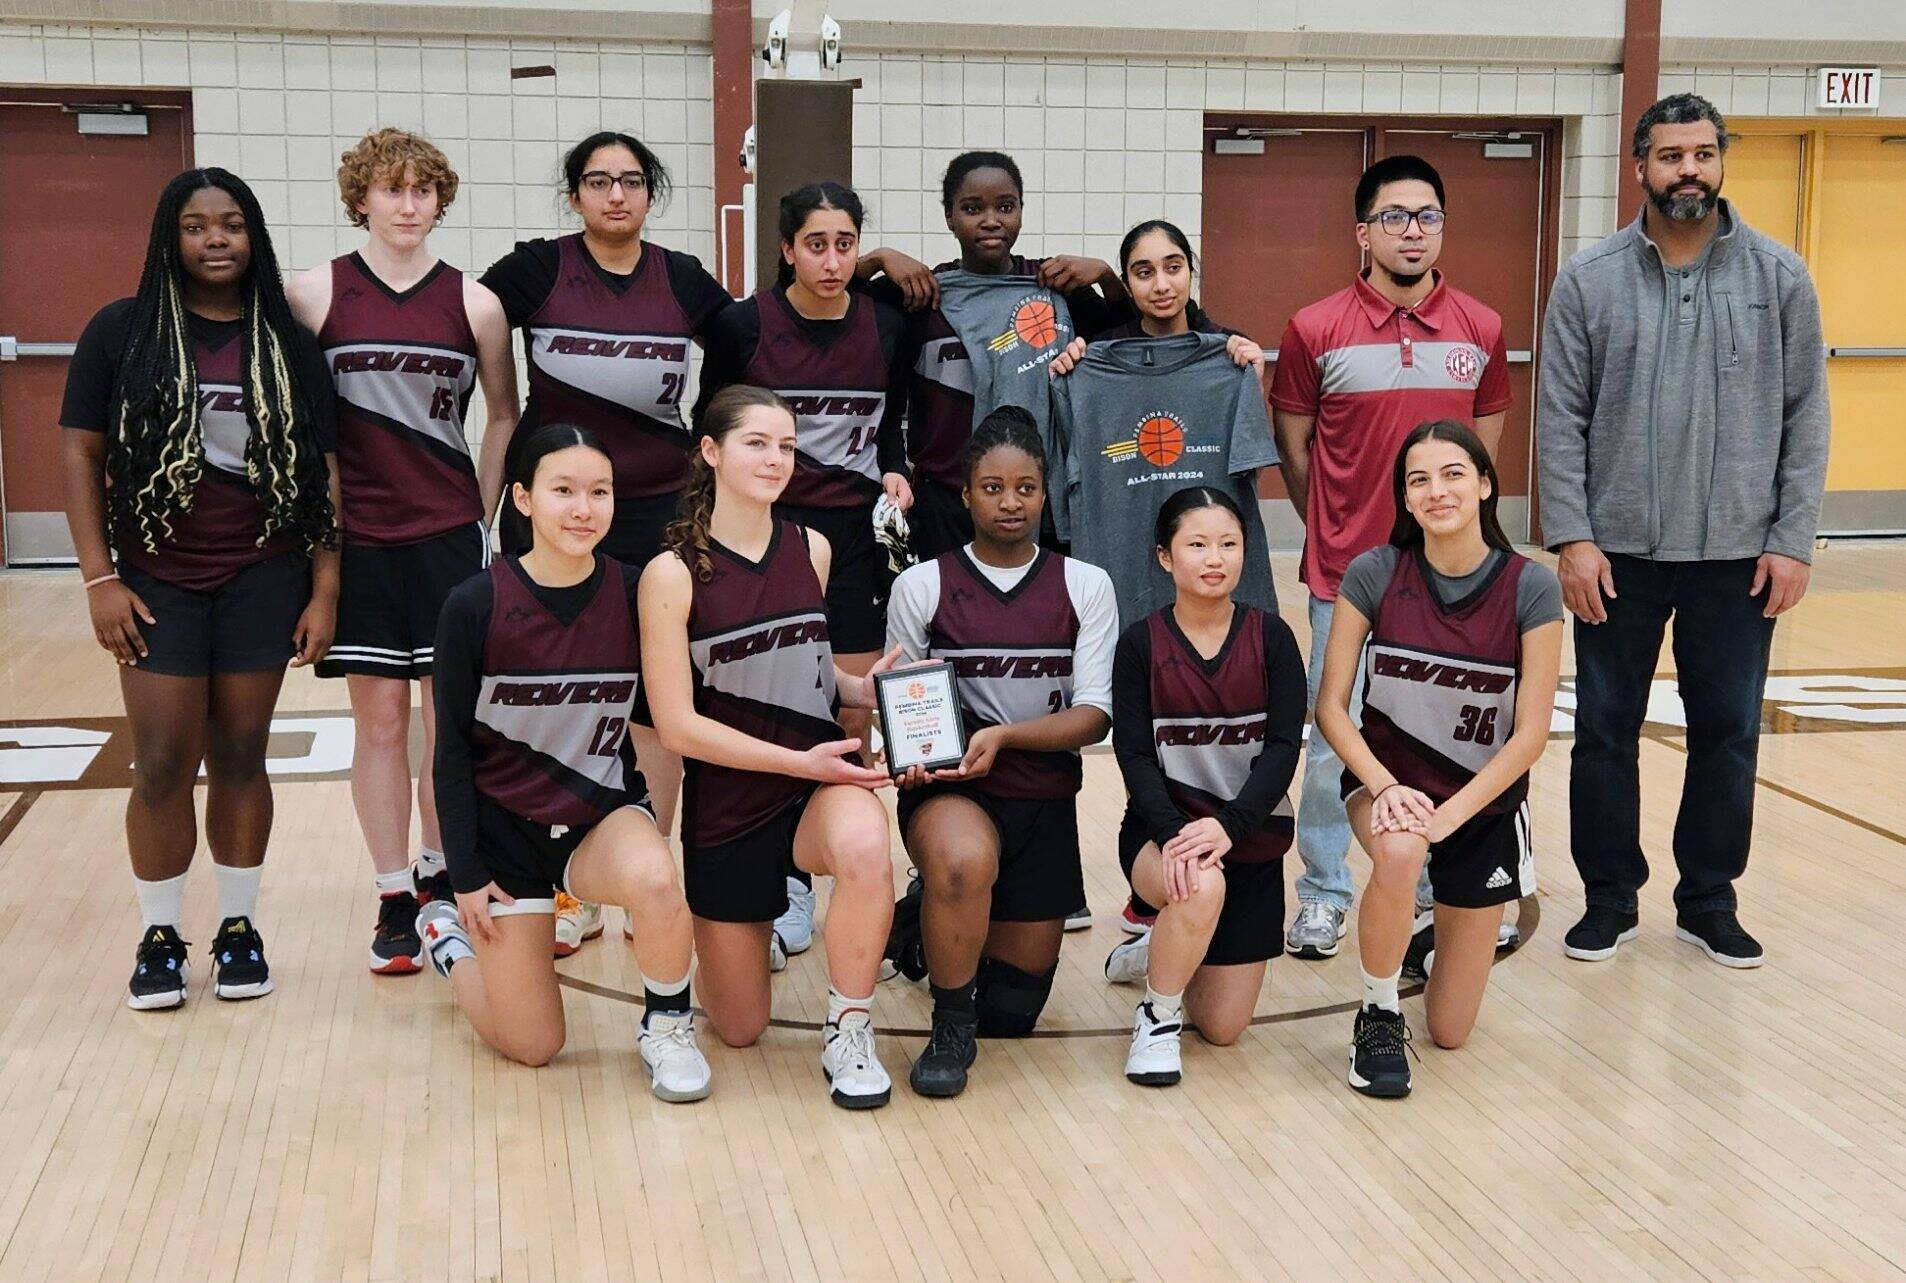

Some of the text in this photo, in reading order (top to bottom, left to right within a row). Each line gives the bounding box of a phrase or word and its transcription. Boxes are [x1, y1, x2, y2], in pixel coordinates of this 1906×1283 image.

[1827, 72, 1873, 104] EXIT
[546, 335, 686, 362] REIVERS
[333, 351, 465, 379] REIVERS
[656, 372, 685, 405] 21
[429, 386, 454, 421] 15
[1112, 445, 1221, 463] BISON CLASSIC
[1127, 471, 1203, 486] ALL-STAR 2024
[489, 680, 635, 706] REIVERS
[587, 716, 626, 757] 12
[1156, 720, 1266, 747] REIVER
[1453, 704, 1498, 746] 36
